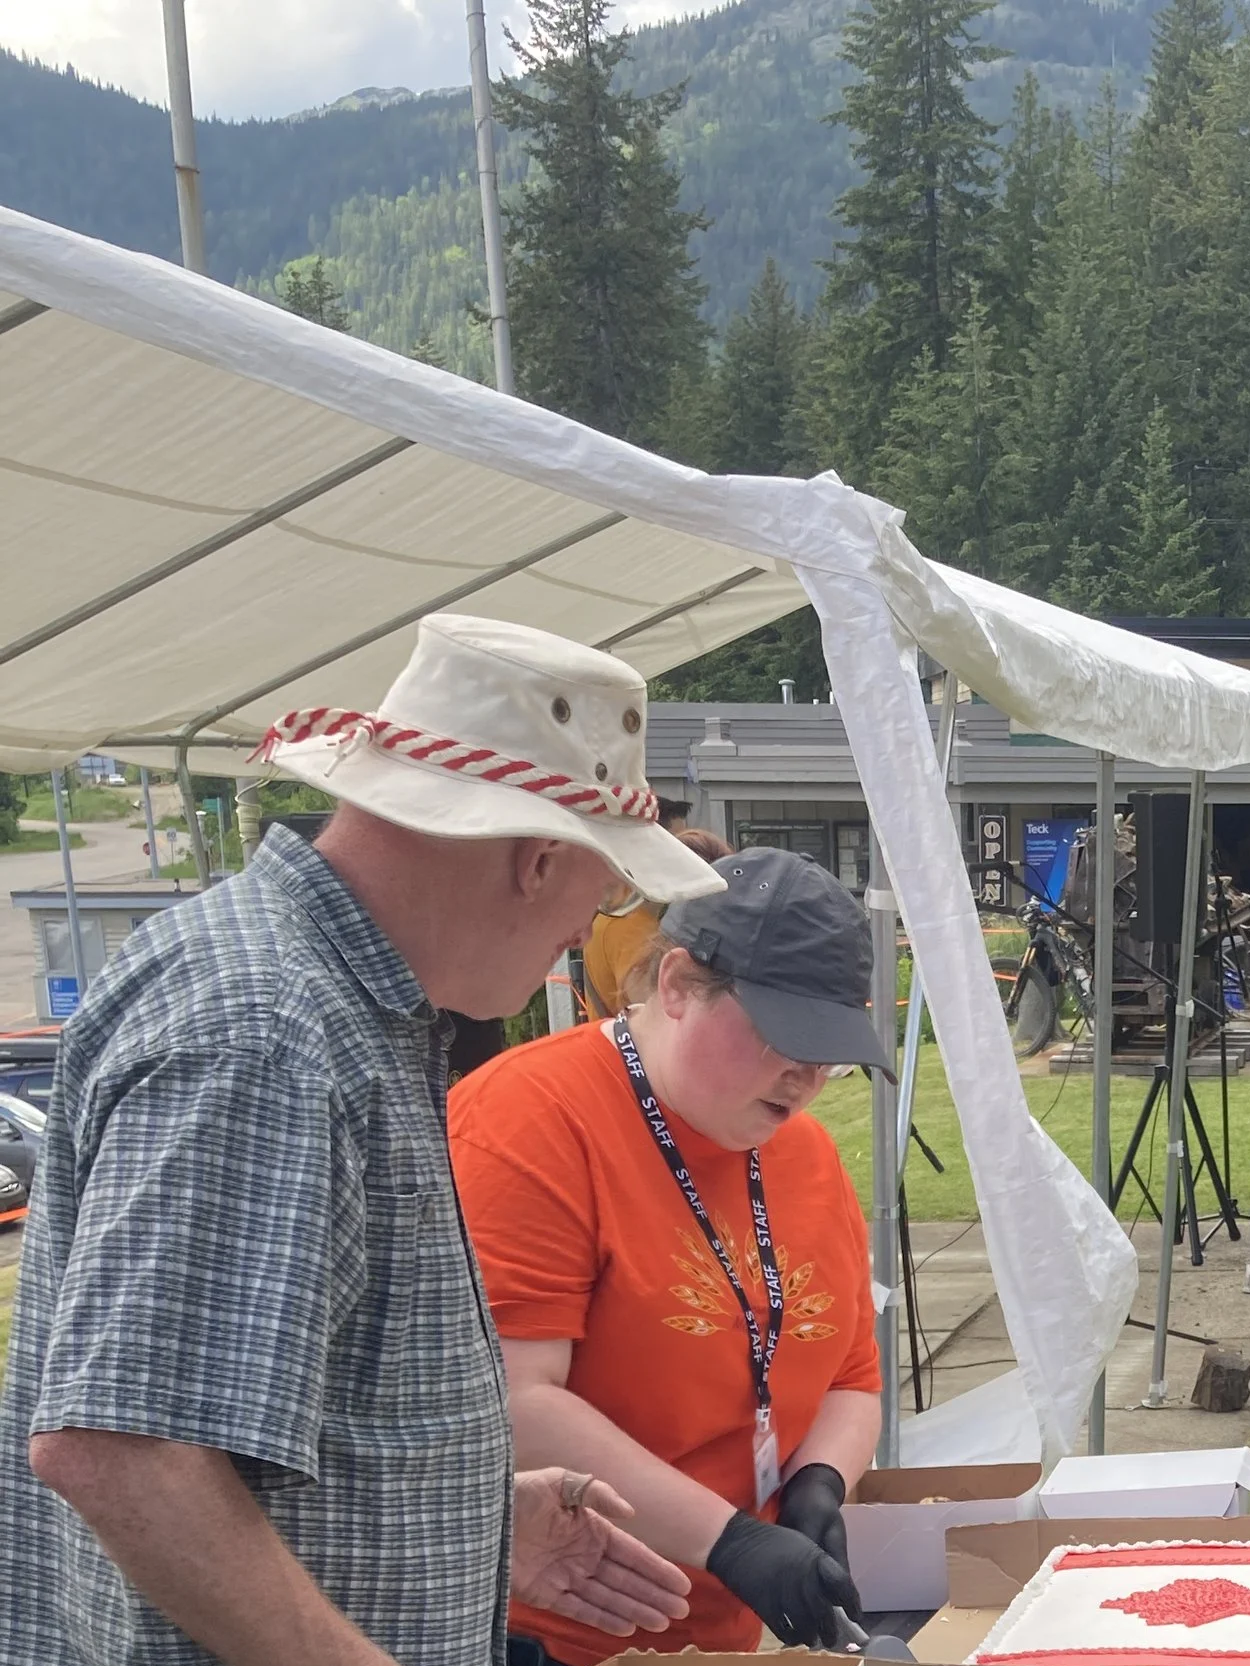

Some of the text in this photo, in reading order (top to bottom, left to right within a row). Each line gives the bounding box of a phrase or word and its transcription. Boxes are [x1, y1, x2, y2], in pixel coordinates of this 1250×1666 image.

[1026, 823, 1049, 834] Teck
[617, 1031, 645, 1078] STAFF
[641, 1096, 675, 1149] STAFF
[750, 1150, 760, 1182] STA
[676, 1167, 708, 1219] STAFF
[751, 1199, 772, 1248] STAFF
[711, 1238, 743, 1290] STAFF
[762, 1263, 783, 1310] STAFF
[745, 1310, 762, 1363] STAFF
